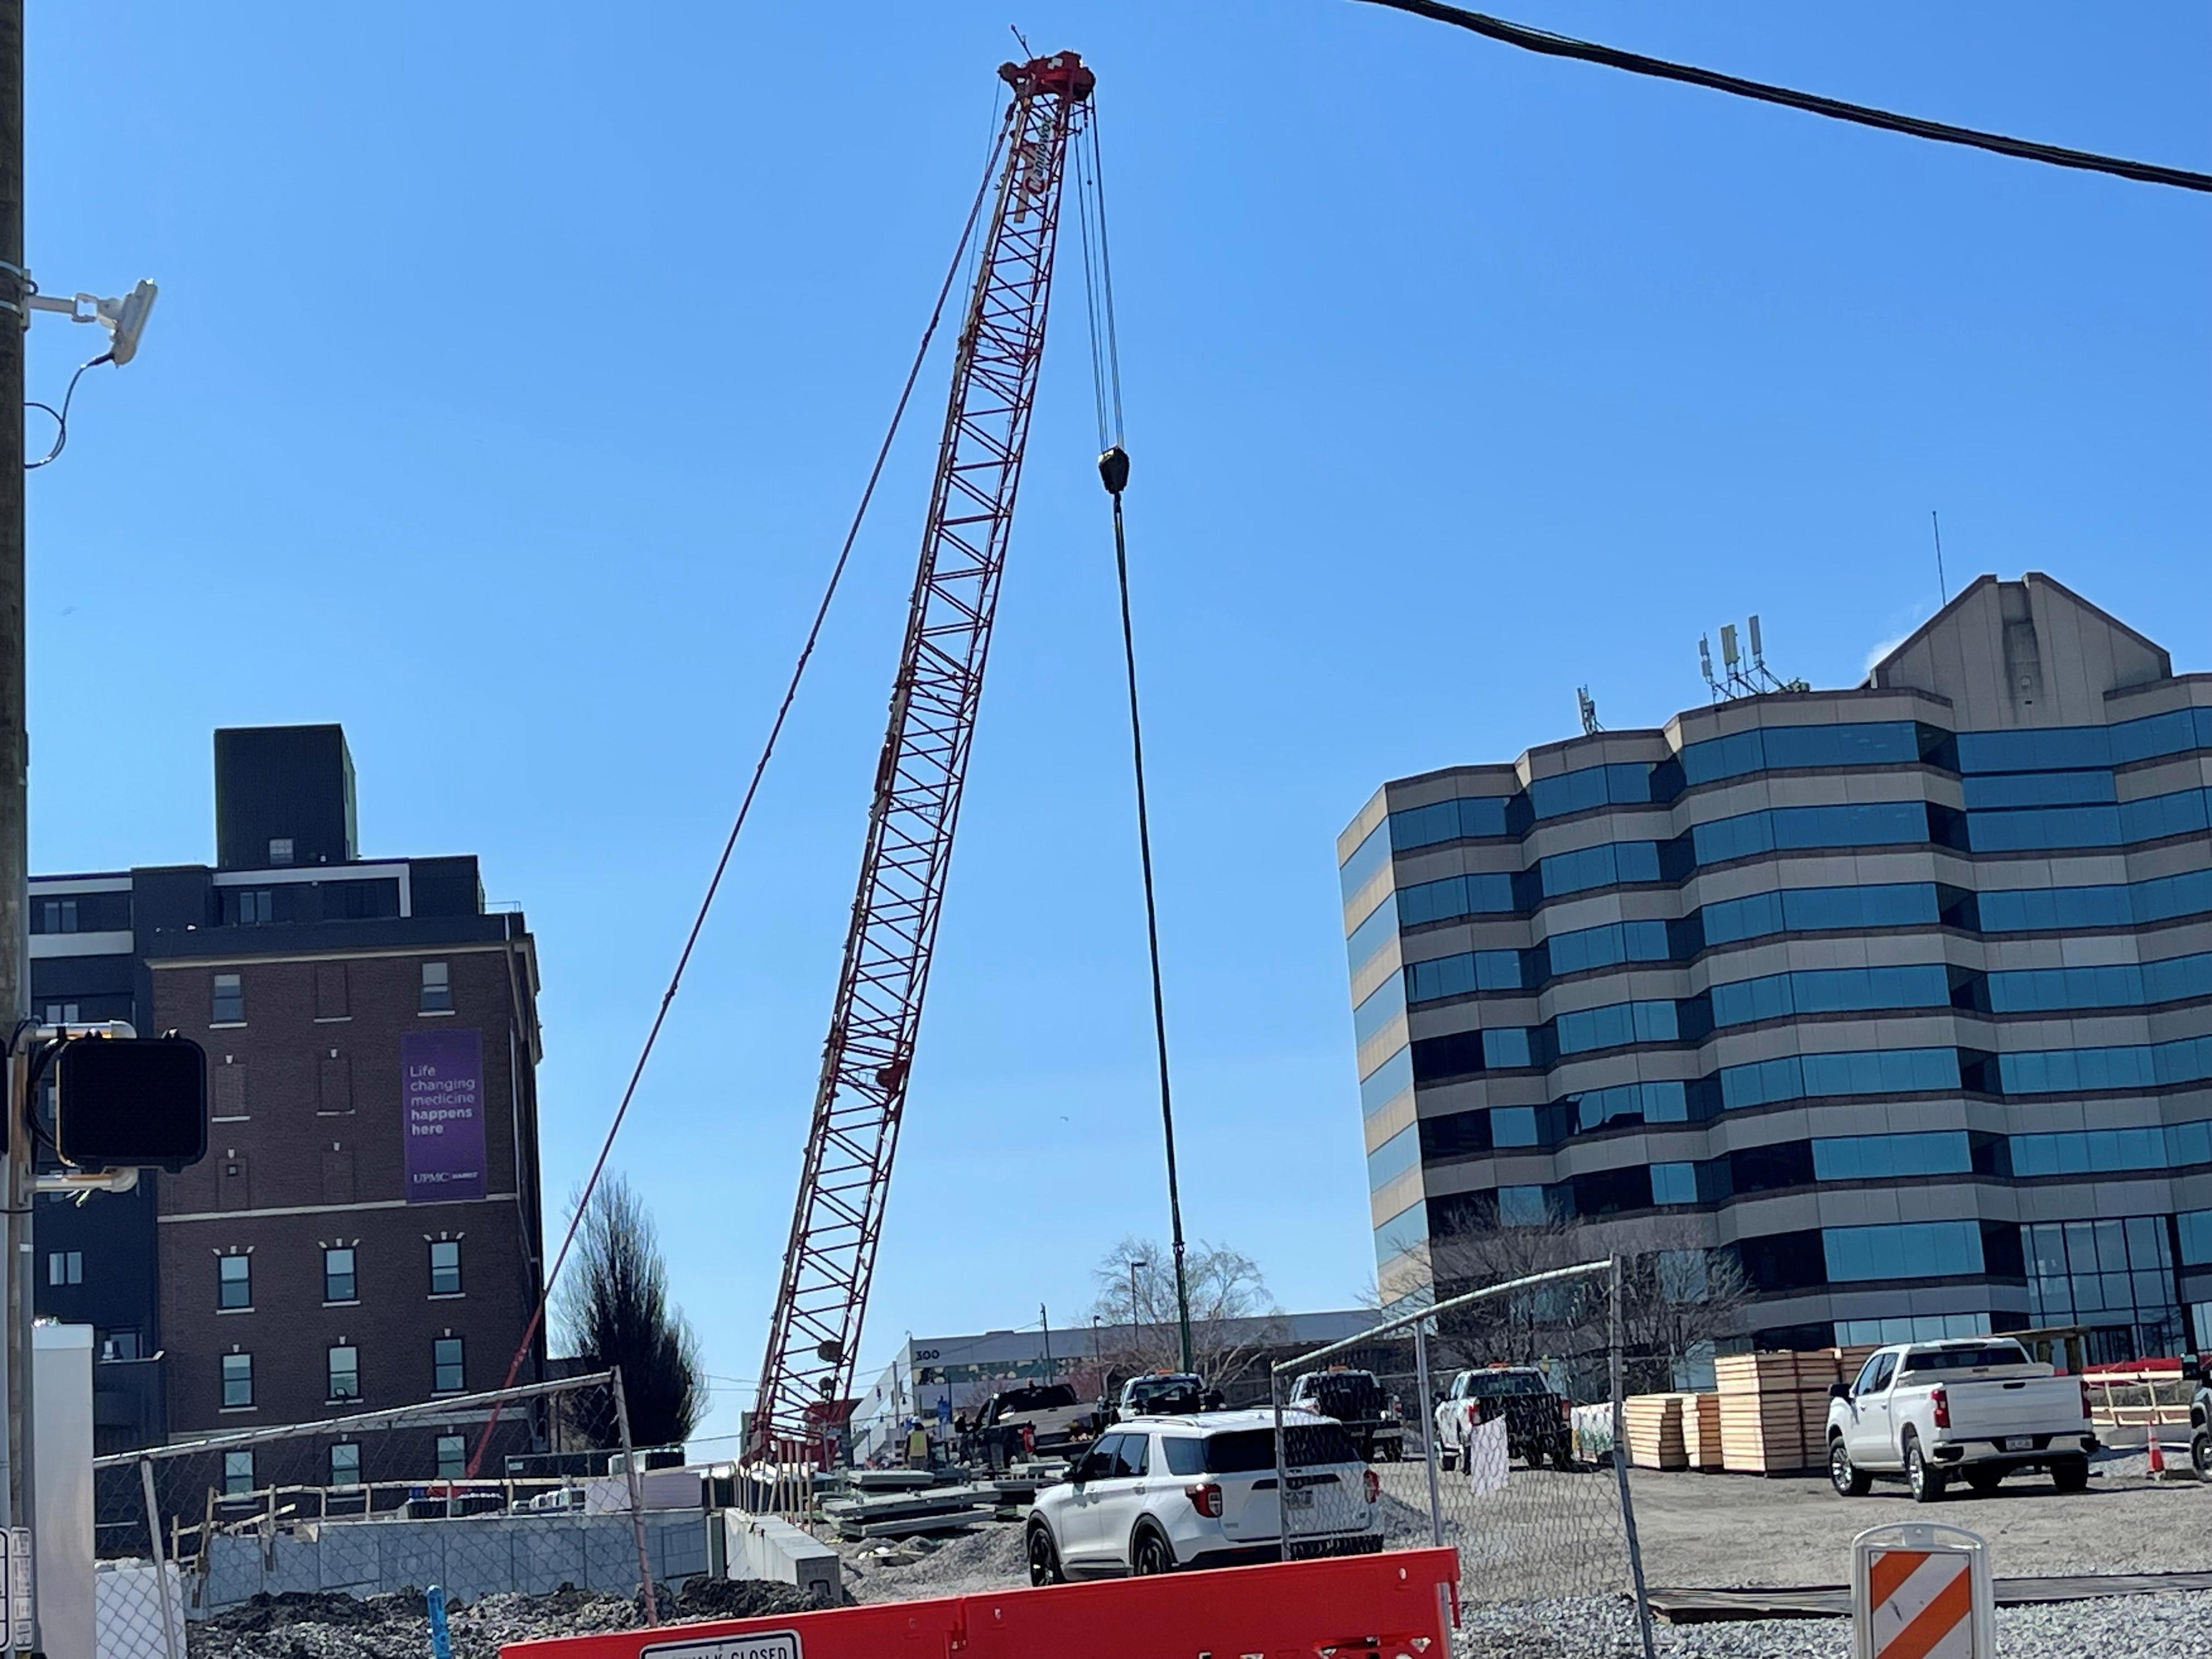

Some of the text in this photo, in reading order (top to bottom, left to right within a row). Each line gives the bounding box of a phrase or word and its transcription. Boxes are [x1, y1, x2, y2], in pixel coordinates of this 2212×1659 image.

[410, 1065, 435, 1077] Life
[410, 1079, 475, 1092] changing
[411, 1093, 475, 1106] medicine
[411, 1108, 473, 1121] happens
[412, 1123, 444, 1136] here
[413, 1172, 449, 1184] UPMC
[916, 1349, 940, 1361] 300
